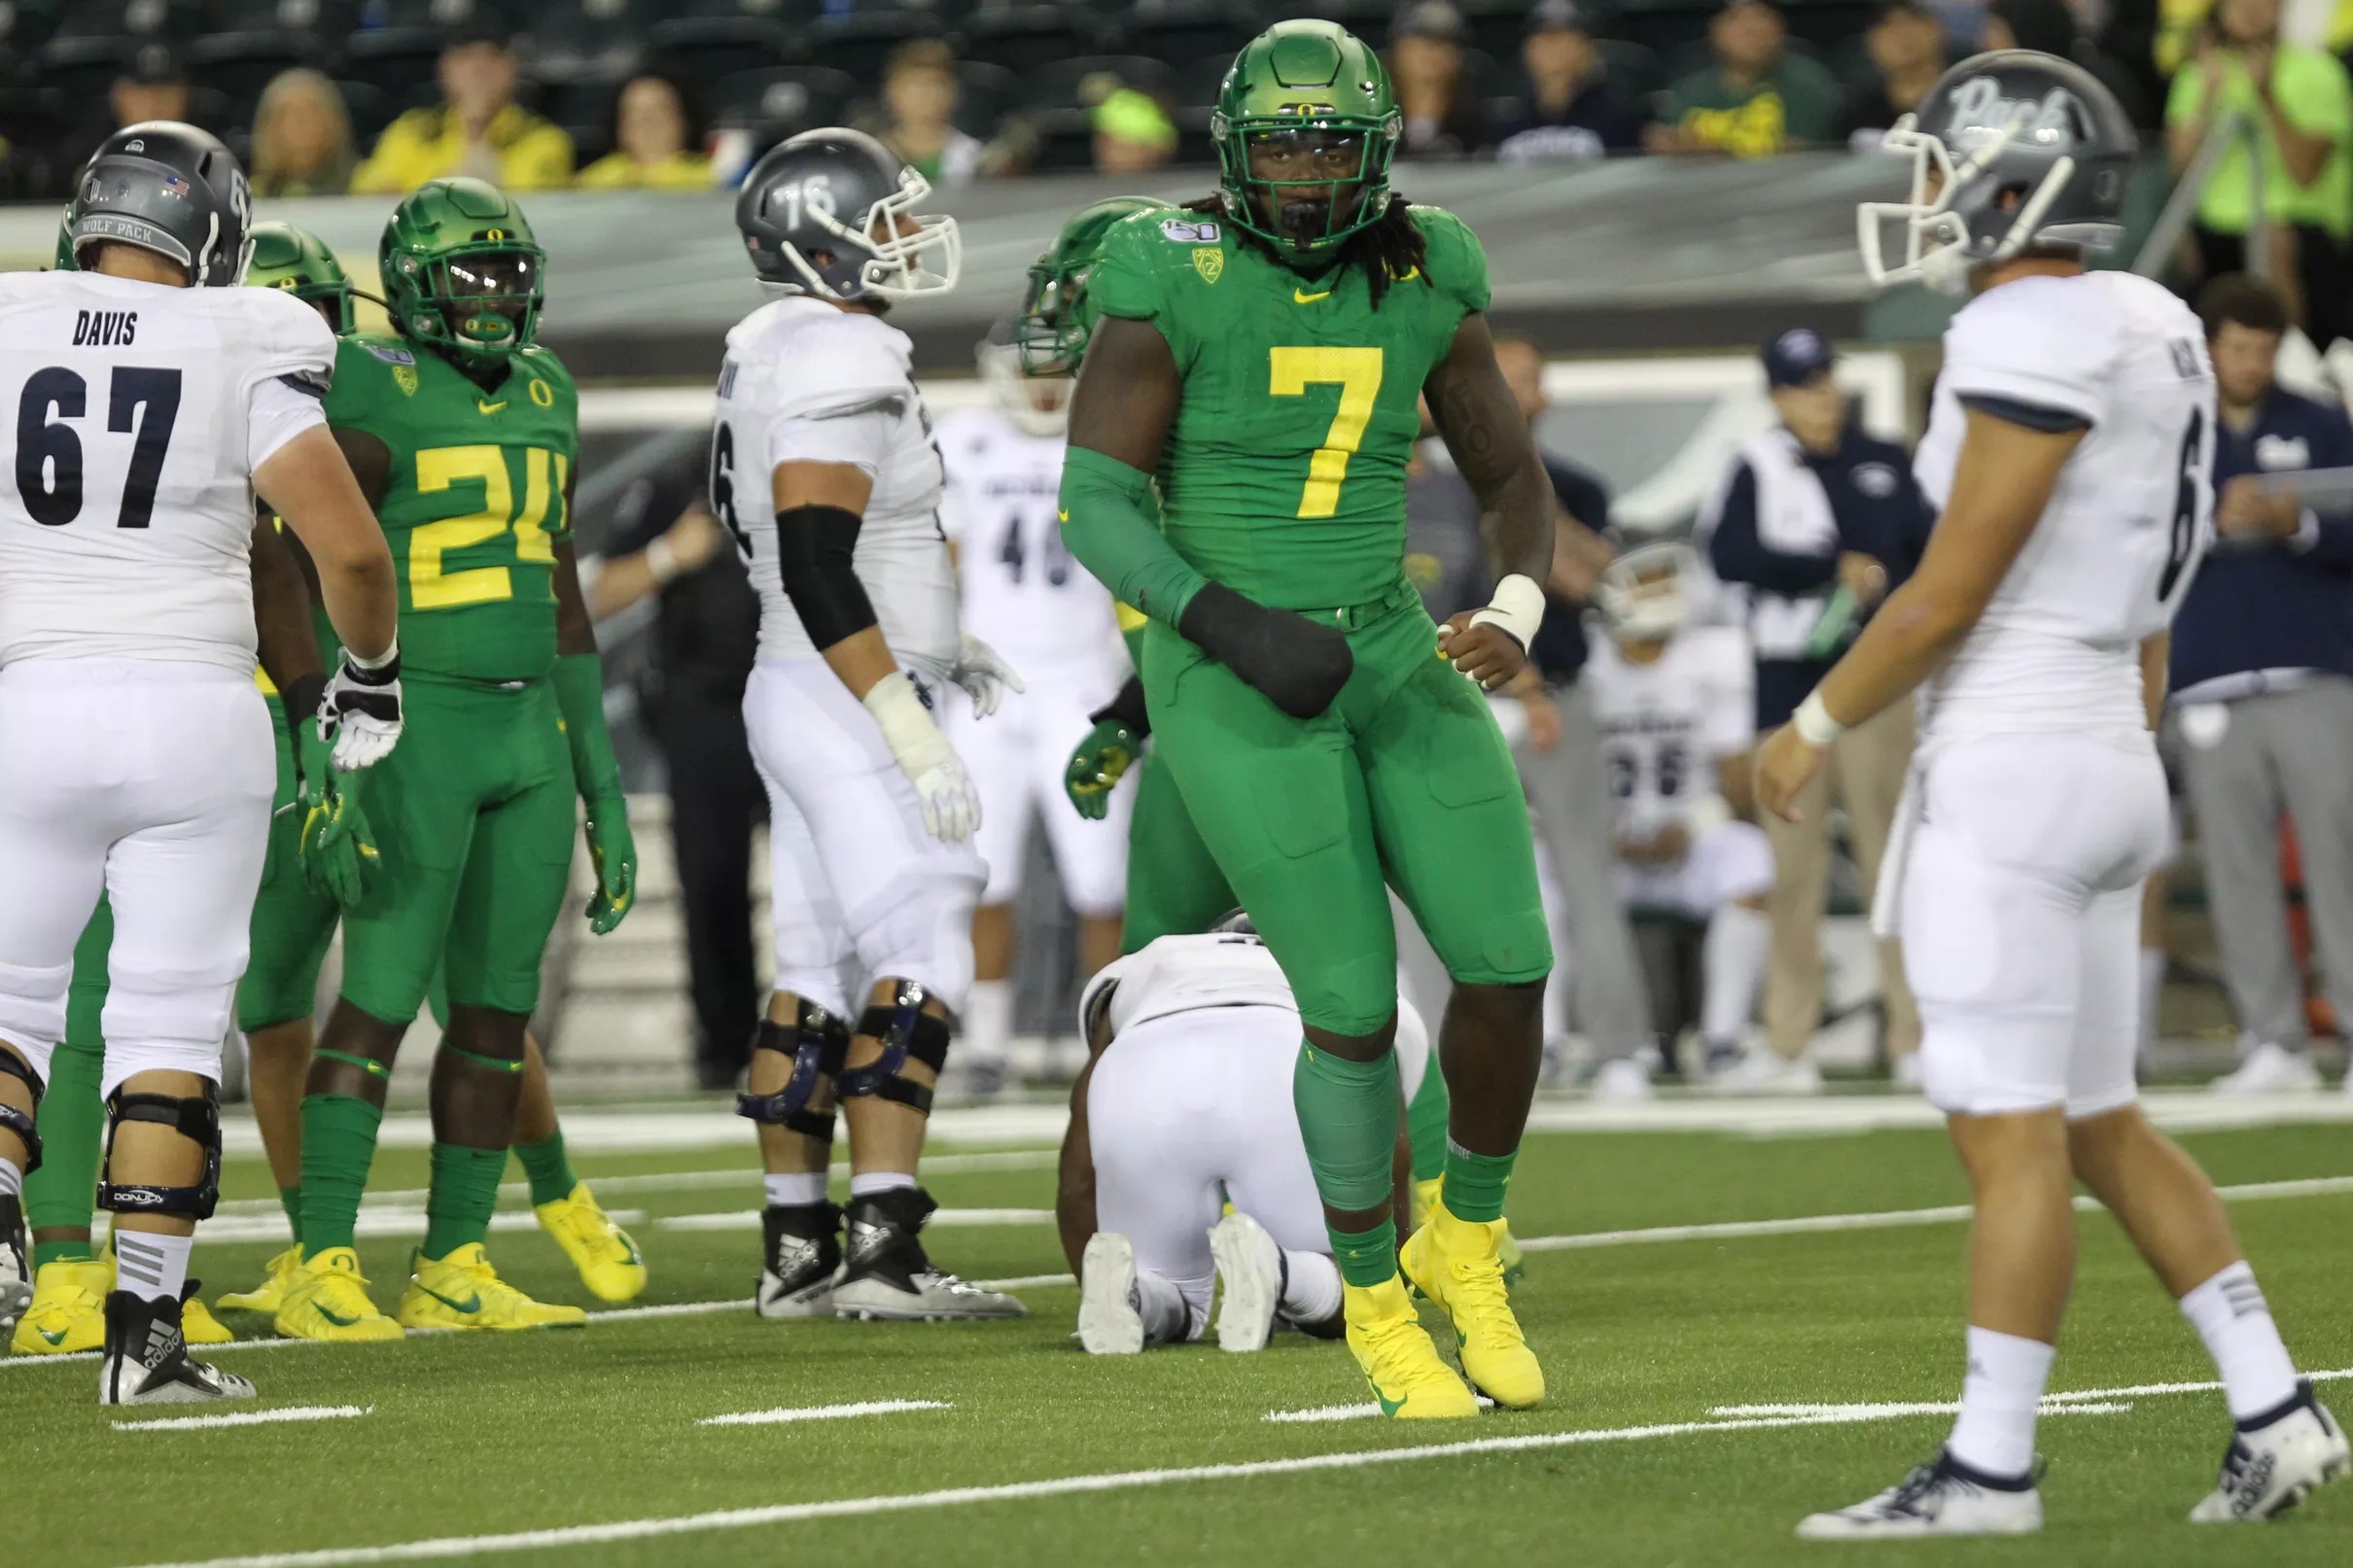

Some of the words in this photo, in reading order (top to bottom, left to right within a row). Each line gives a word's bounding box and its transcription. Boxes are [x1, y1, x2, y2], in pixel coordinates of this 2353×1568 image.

[1949, 76, 2074, 152] Pack
[83, 220, 113, 233] WOLF
[117, 223, 152, 242] PACK
[772, 175, 836, 231] 76
[72, 309, 137, 346] DAVIS
[15, 366, 183, 529] 67
[1270, 346, 1384, 518] 7
[408, 443, 568, 610] 24
[114, 1192, 164, 1204] DONJOY
[144, 1327, 183, 1370] adida
